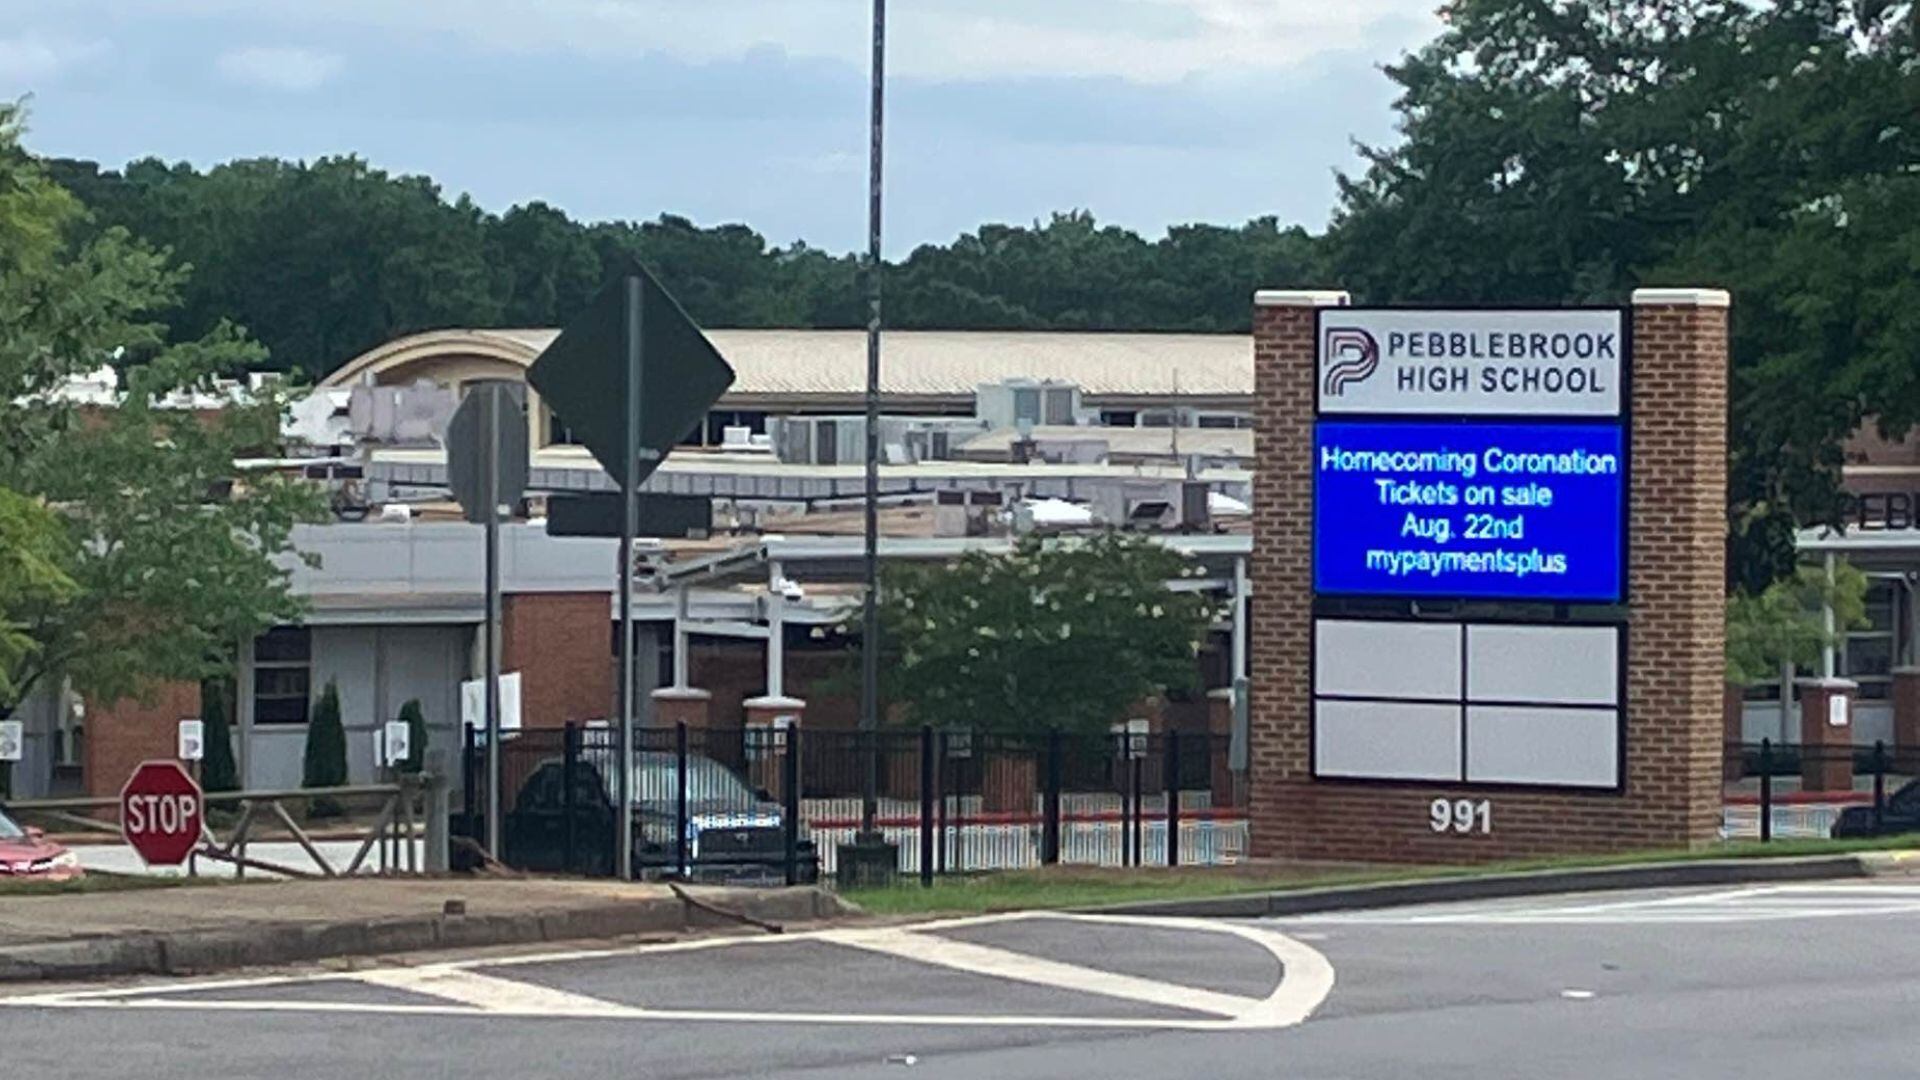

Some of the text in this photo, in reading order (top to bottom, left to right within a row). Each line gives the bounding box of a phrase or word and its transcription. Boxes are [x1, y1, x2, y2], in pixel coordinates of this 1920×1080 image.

[1388, 332, 1615, 359] PEBBLEBROOK
[1397, 366, 1605, 393] HIGH SCHOOL
[1320, 446, 1617, 478] Homecoming Coronation
[1374, 478, 1553, 507] Tickets on sale
[1401, 511, 1524, 543] Aug. 22nd
[1366, 547, 1567, 577] mypaymentsplus
[128, 794, 196, 834] STOP
[1430, 798, 1491, 834] 991
